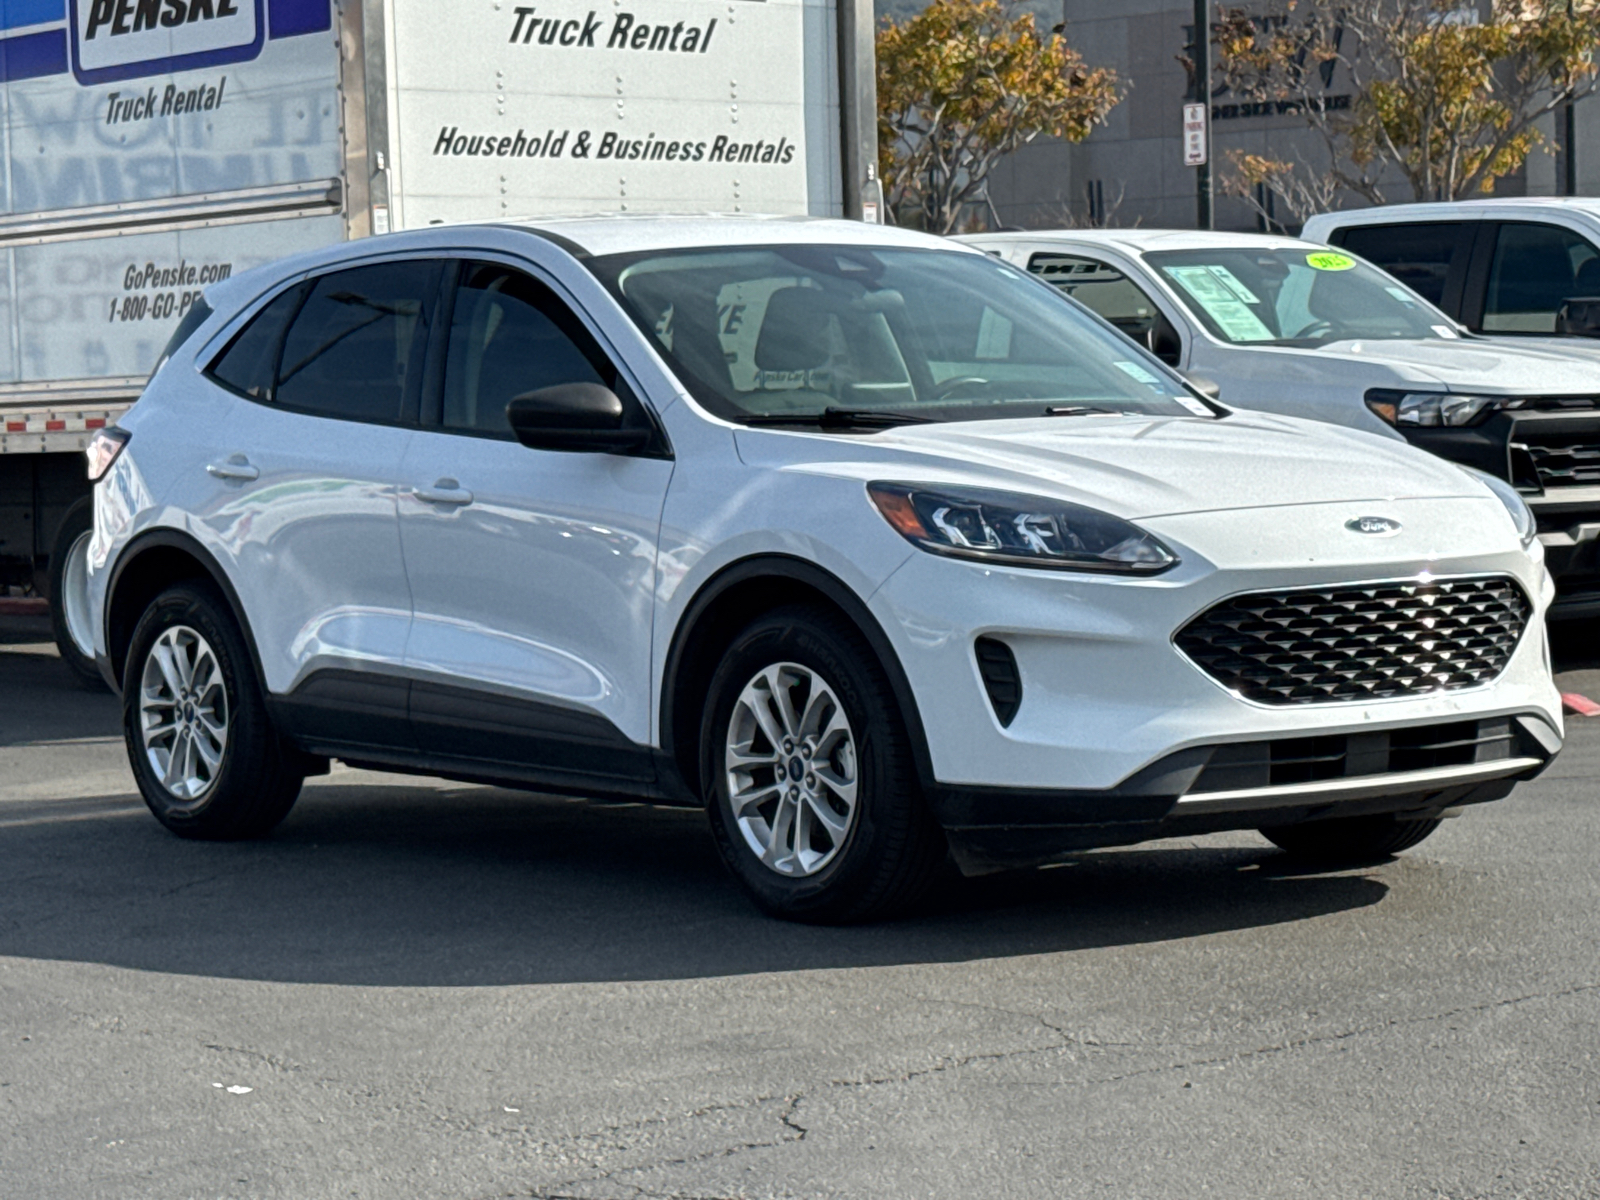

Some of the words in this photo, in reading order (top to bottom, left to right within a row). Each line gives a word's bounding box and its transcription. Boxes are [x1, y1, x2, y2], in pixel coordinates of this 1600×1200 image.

[508, 6, 603, 48] Truck
[606, 12, 719, 54] Rental
[105, 86, 158, 125] Truck
[160, 75, 227, 118] Rental
[433, 126, 570, 158] Household
[570, 130, 592, 159] &
[596, 131, 707, 162] Business
[708, 135, 796, 164] Rentals
[123, 259, 233, 291] GoPenske.com
